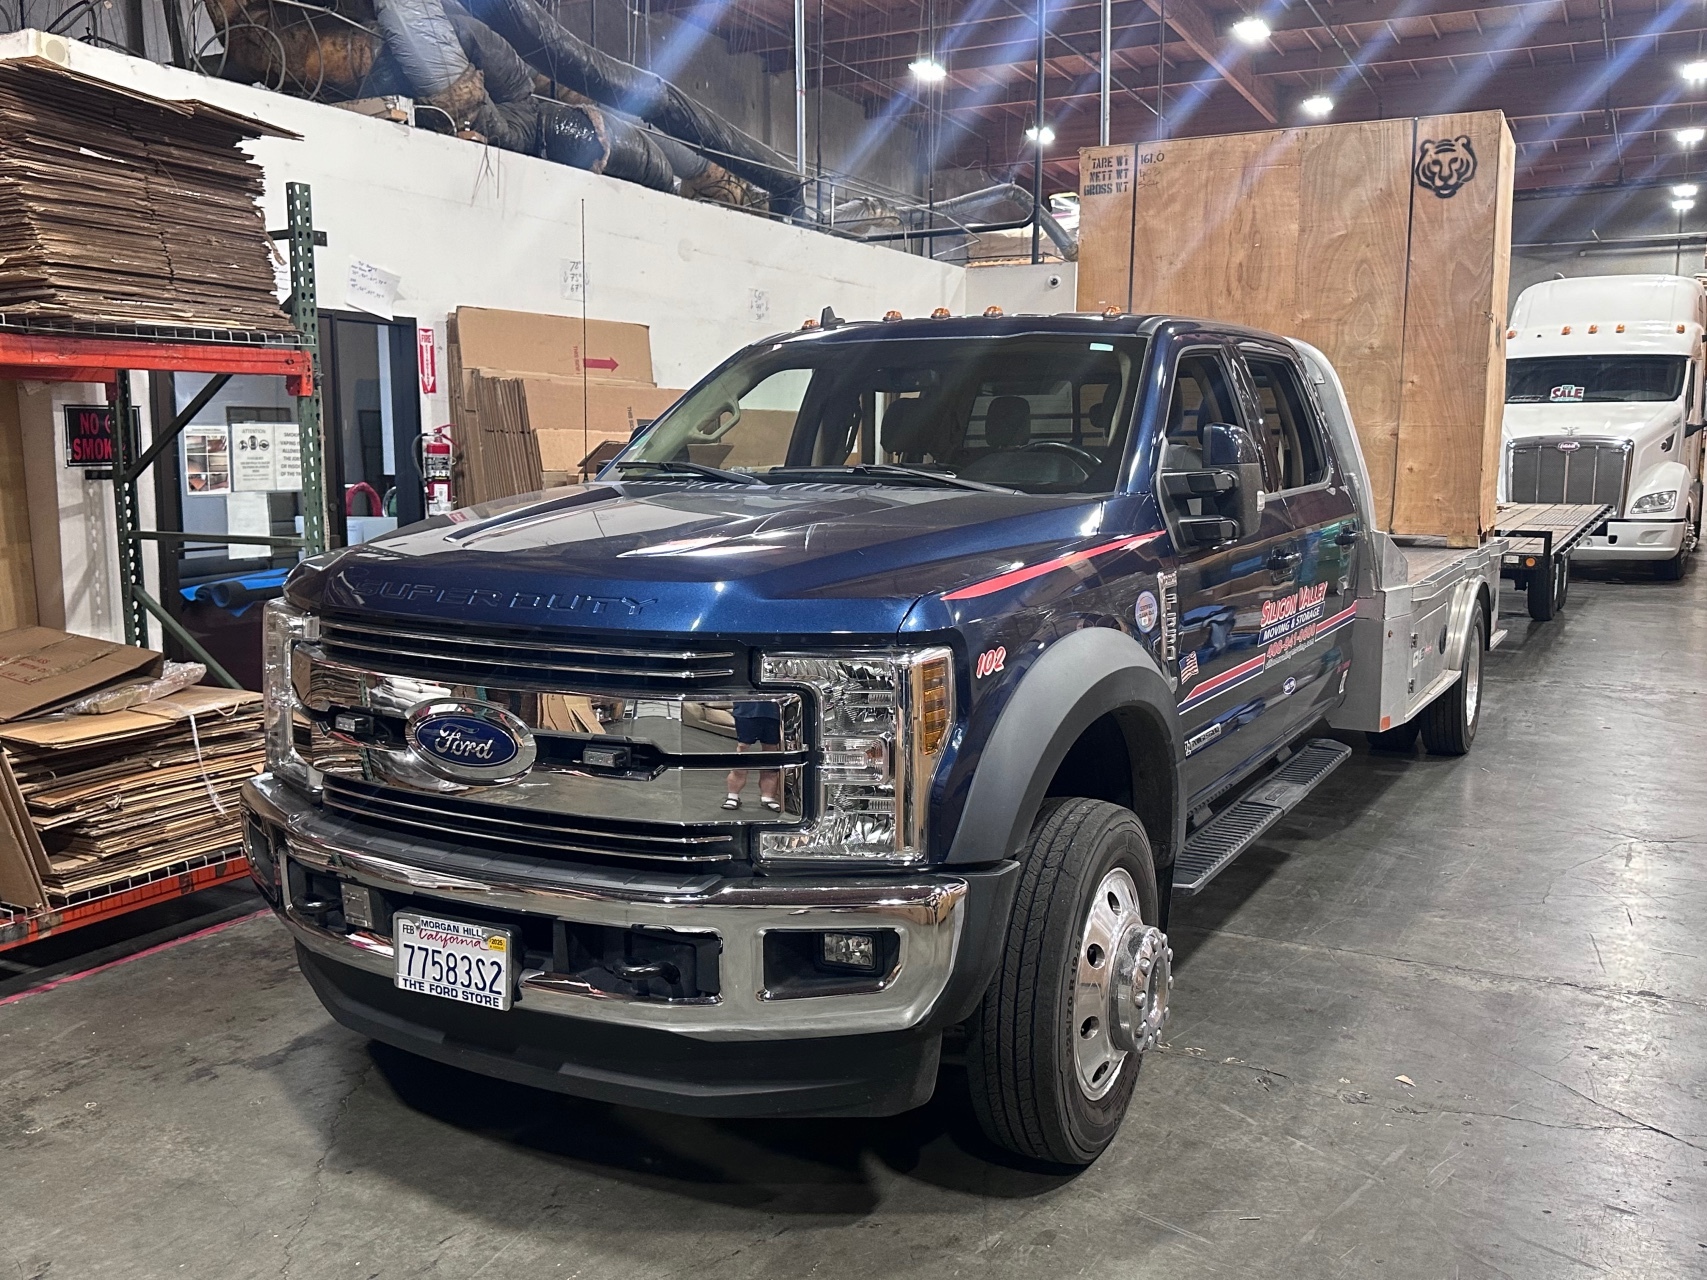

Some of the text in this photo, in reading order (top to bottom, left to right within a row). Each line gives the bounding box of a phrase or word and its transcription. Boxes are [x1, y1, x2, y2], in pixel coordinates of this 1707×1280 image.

[1092, 154, 1129, 169] TARE WT
[1140, 152, 1165, 165] 161.0
[1089, 168, 1129, 183] NETT WT
[1083, 182, 1129, 196] GROSS WT
[421, 334, 432, 344] FIRE
[1552, 387, 1584, 399] SALE
[80, 412, 100, 435] NO
[73, 437, 113, 461] SMOK
[353, 583, 658, 615] SUPER DUTY
[1260, 581, 1329, 627] SILICON VALLEY
[1263, 621, 1290, 641] MOVING
[1296, 606, 1320, 626] STORAGE
[976, 646, 1007, 679] 102
[435, 722, 494, 759] Ford
[402, 924, 415, 935] FEB
[418, 928, 490, 951] California
[420, 919, 482, 938] MORGAN HILL
[403, 943, 503, 995] 77583S2
[402, 977, 500, 1008] THE FORD STORE
